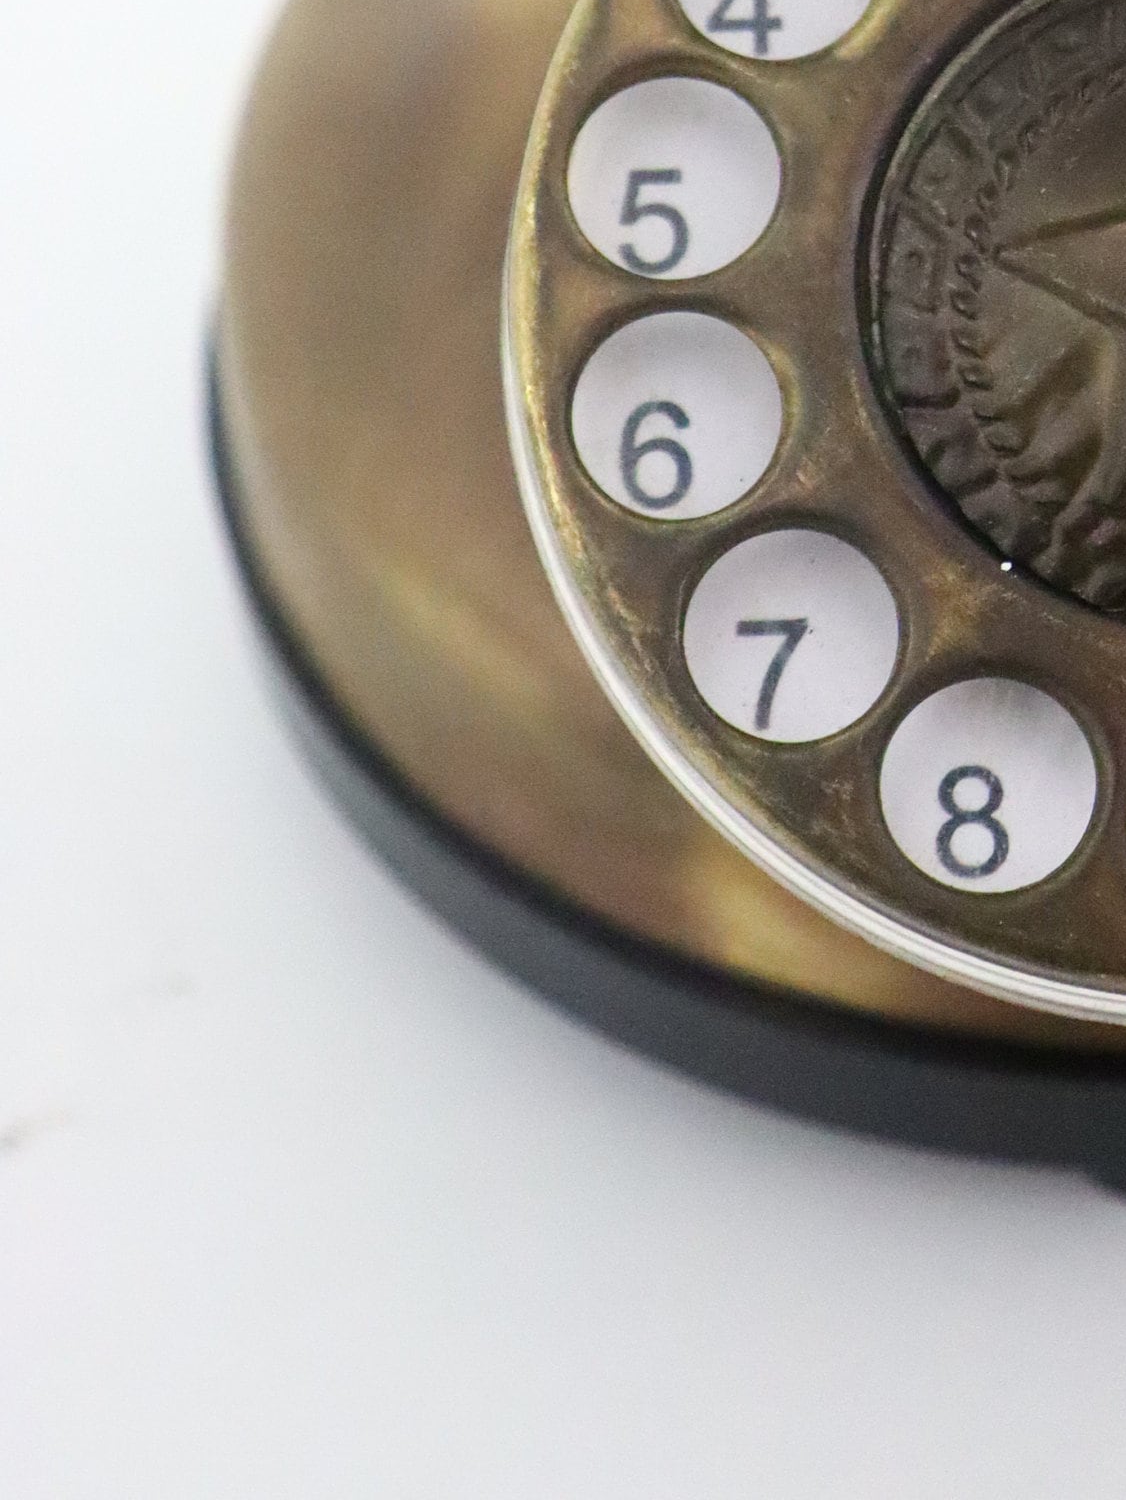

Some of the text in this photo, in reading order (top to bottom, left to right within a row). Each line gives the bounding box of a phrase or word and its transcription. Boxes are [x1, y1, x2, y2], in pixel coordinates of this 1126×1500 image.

[619, 167, 689, 276] 5
[619, 399, 694, 510] 6
[735, 617, 810, 731] 7
[935, 764, 1010, 879] 8
